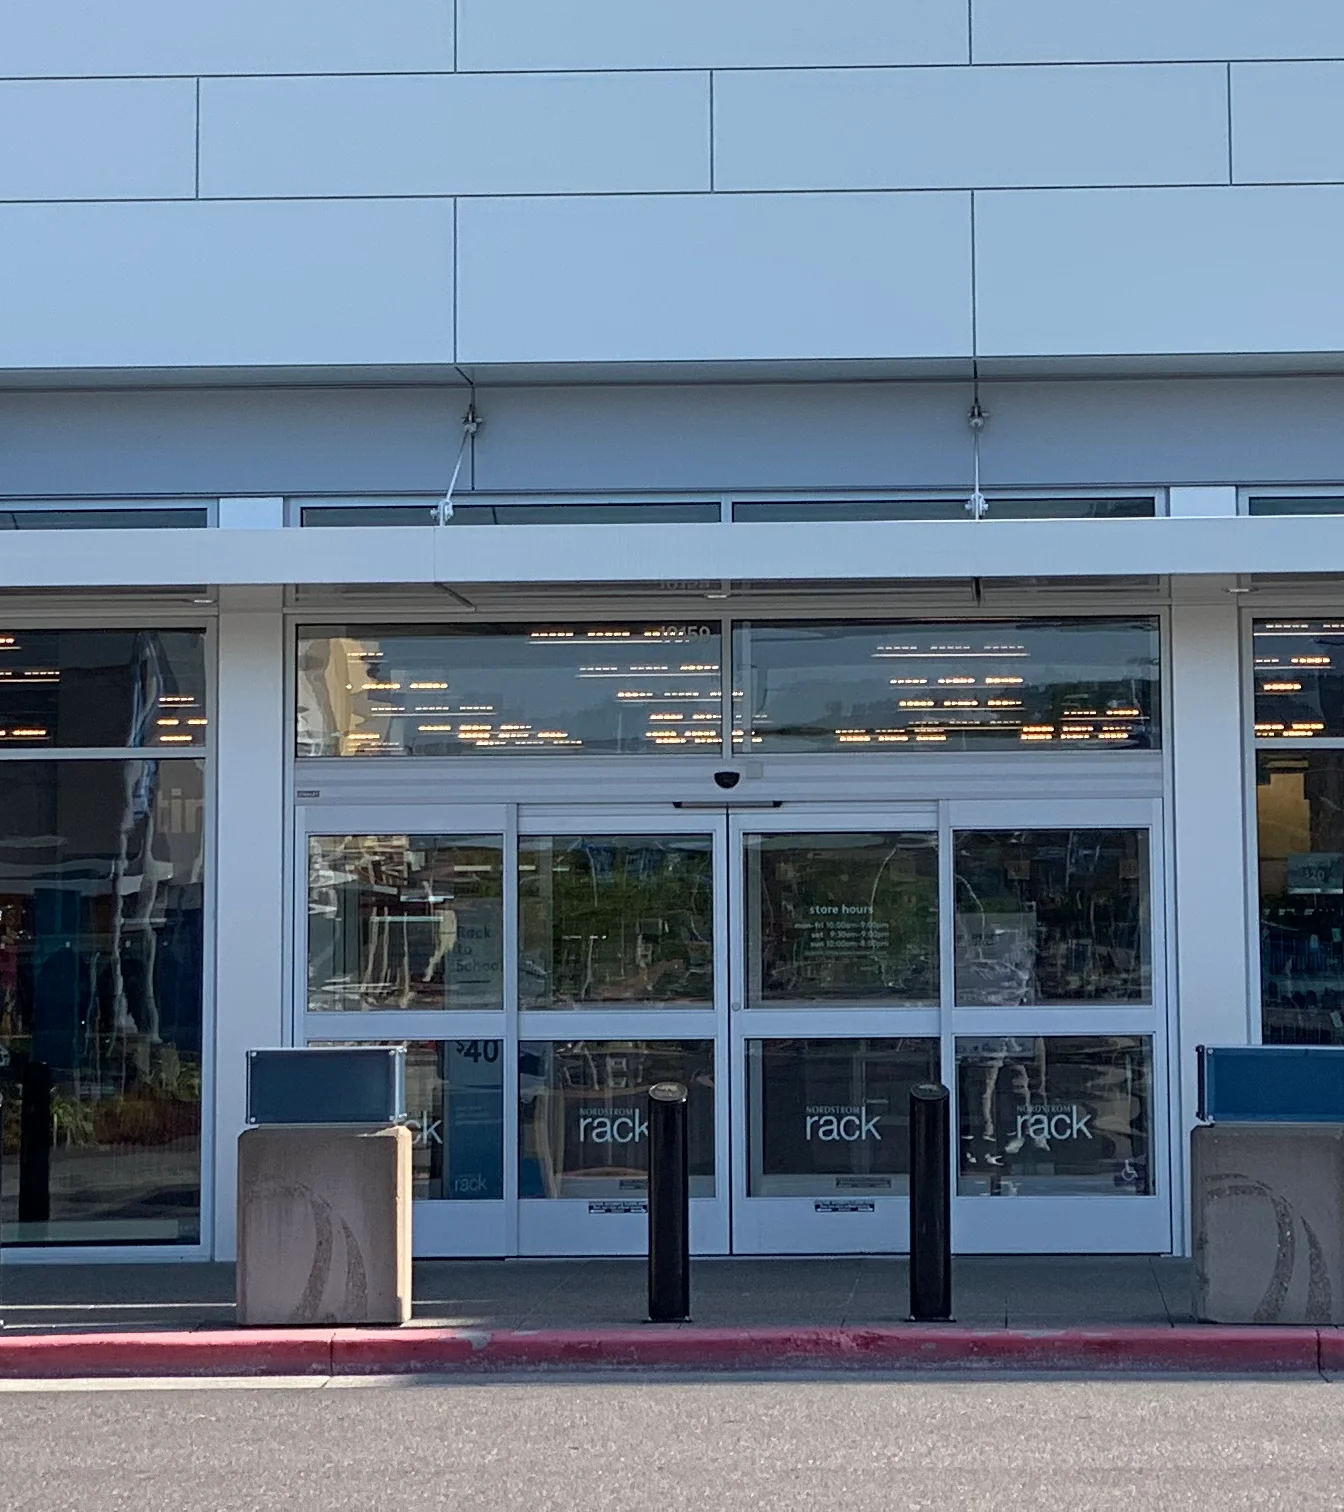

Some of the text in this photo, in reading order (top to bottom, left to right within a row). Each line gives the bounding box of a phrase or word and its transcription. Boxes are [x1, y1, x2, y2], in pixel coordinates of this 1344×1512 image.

[809, 904, 873, 915] store hours
[458, 944, 472, 955] to
[579, 1108, 634, 1116] NORDSTROM
[806, 1106, 861, 1114] NORDSTROM
[579, 1108, 648, 1143] rack
[806, 1106, 882, 1141] rack
[1016, 1104, 1093, 1140] rack
[455, 1174, 488, 1192] rack
